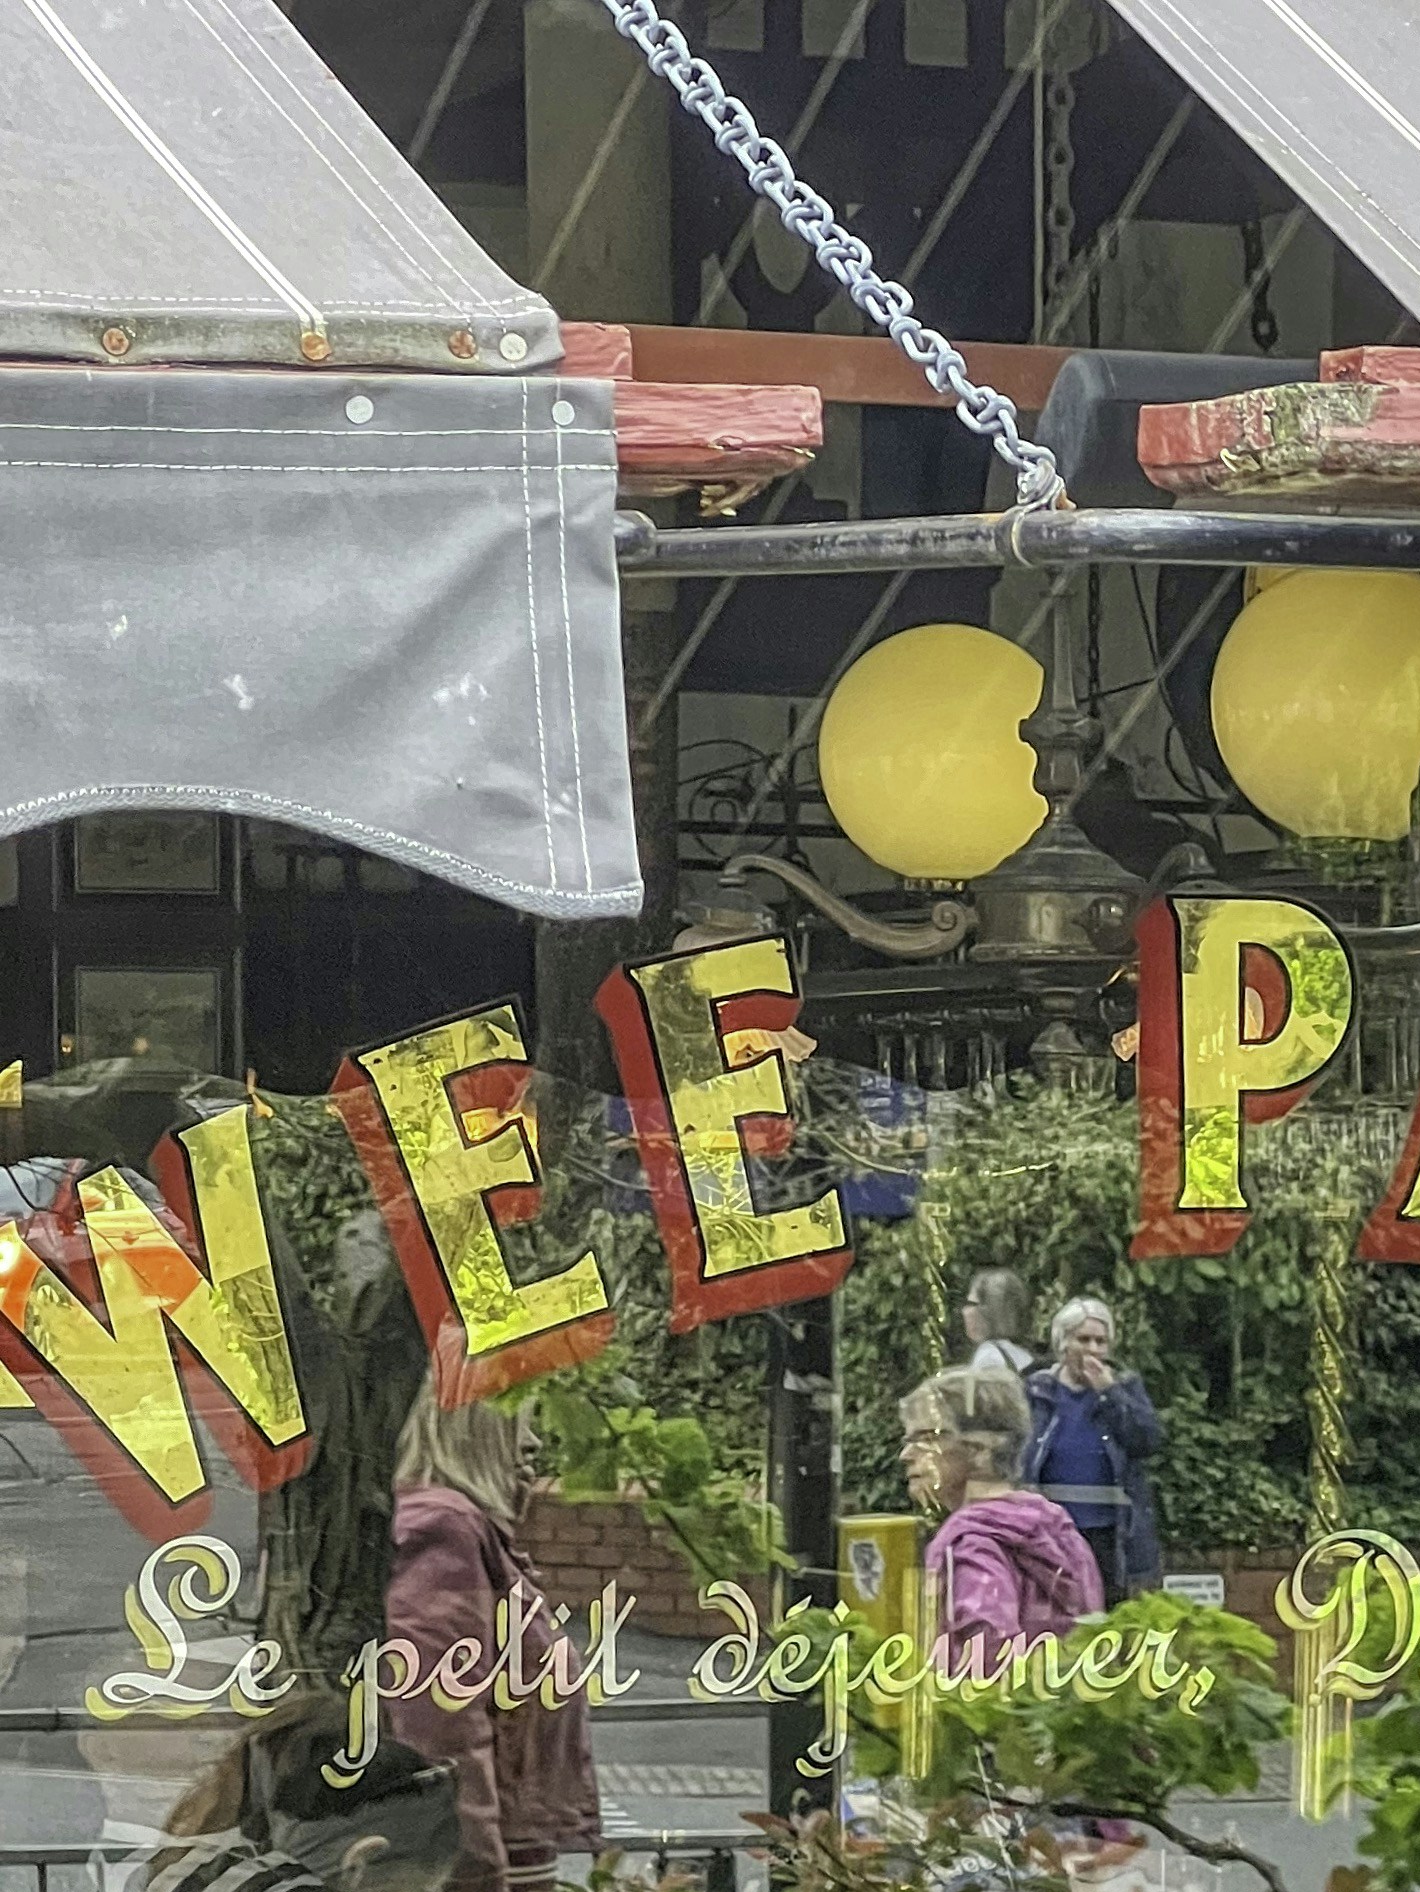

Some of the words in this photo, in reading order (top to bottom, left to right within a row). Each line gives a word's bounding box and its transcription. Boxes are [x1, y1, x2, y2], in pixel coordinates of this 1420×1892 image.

[0, 932, 853, 1546] WEE
[86, 1535, 297, 1720] Le
[320, 1577, 642, 1789] petit
[690, 1578, 1215, 1779] déjeuner,
